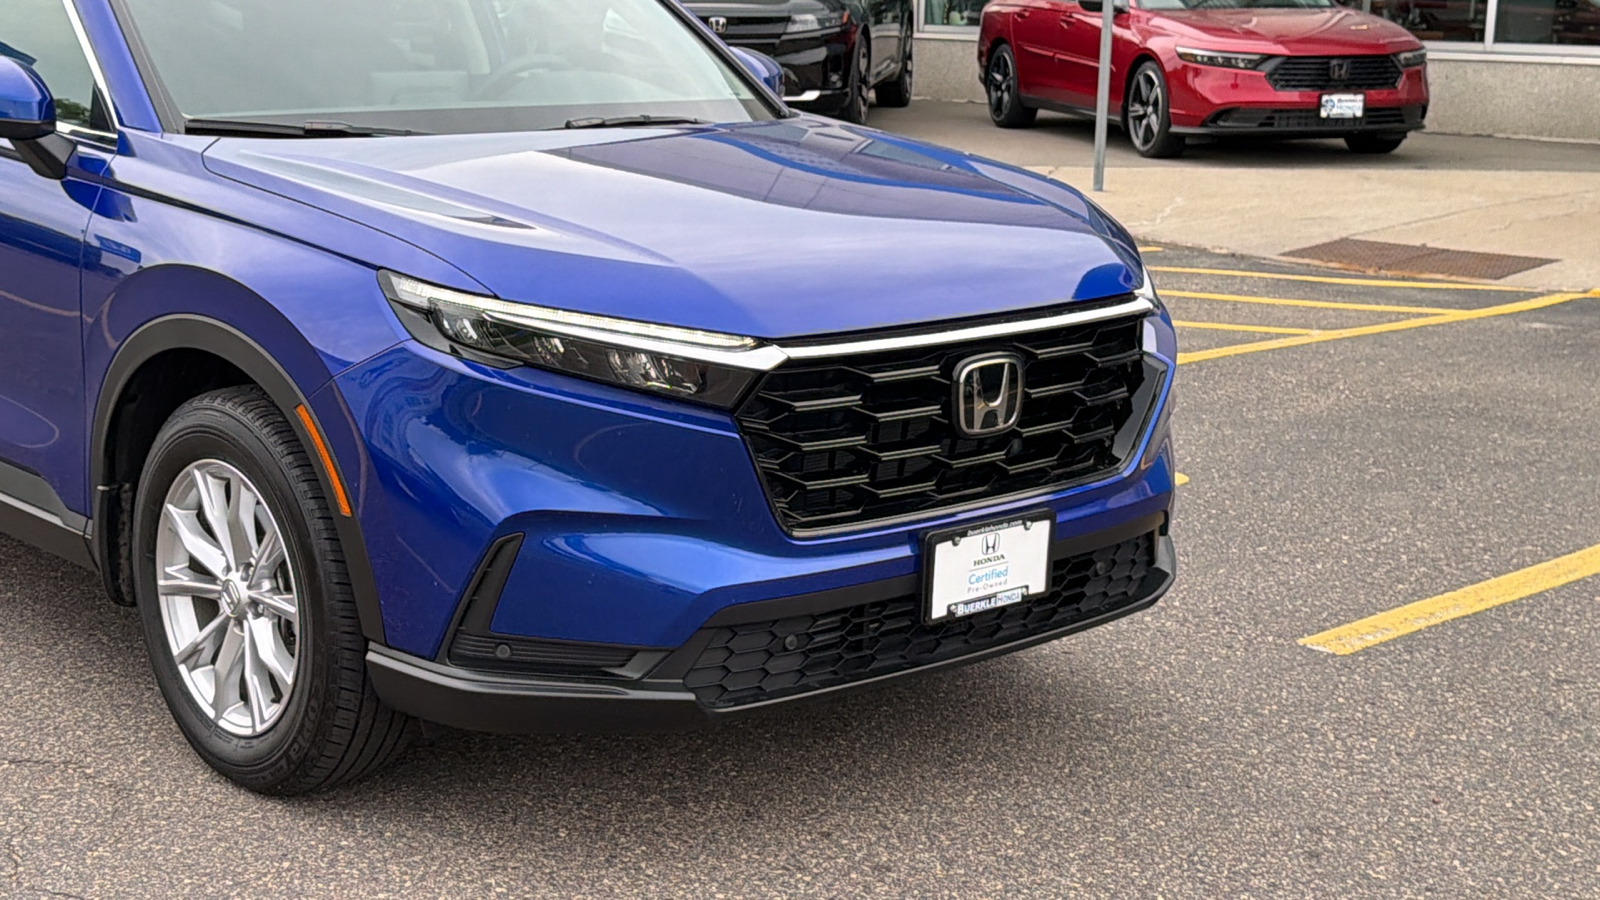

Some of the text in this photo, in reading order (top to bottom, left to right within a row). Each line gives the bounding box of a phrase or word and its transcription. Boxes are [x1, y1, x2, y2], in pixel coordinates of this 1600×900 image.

[973, 554, 1006, 566] HONDA
[968, 565, 1009, 585] Certified
[967, 578, 1008, 594] Pre-Owned
[957, 592, 1020, 615] BUERKLE HONDA
